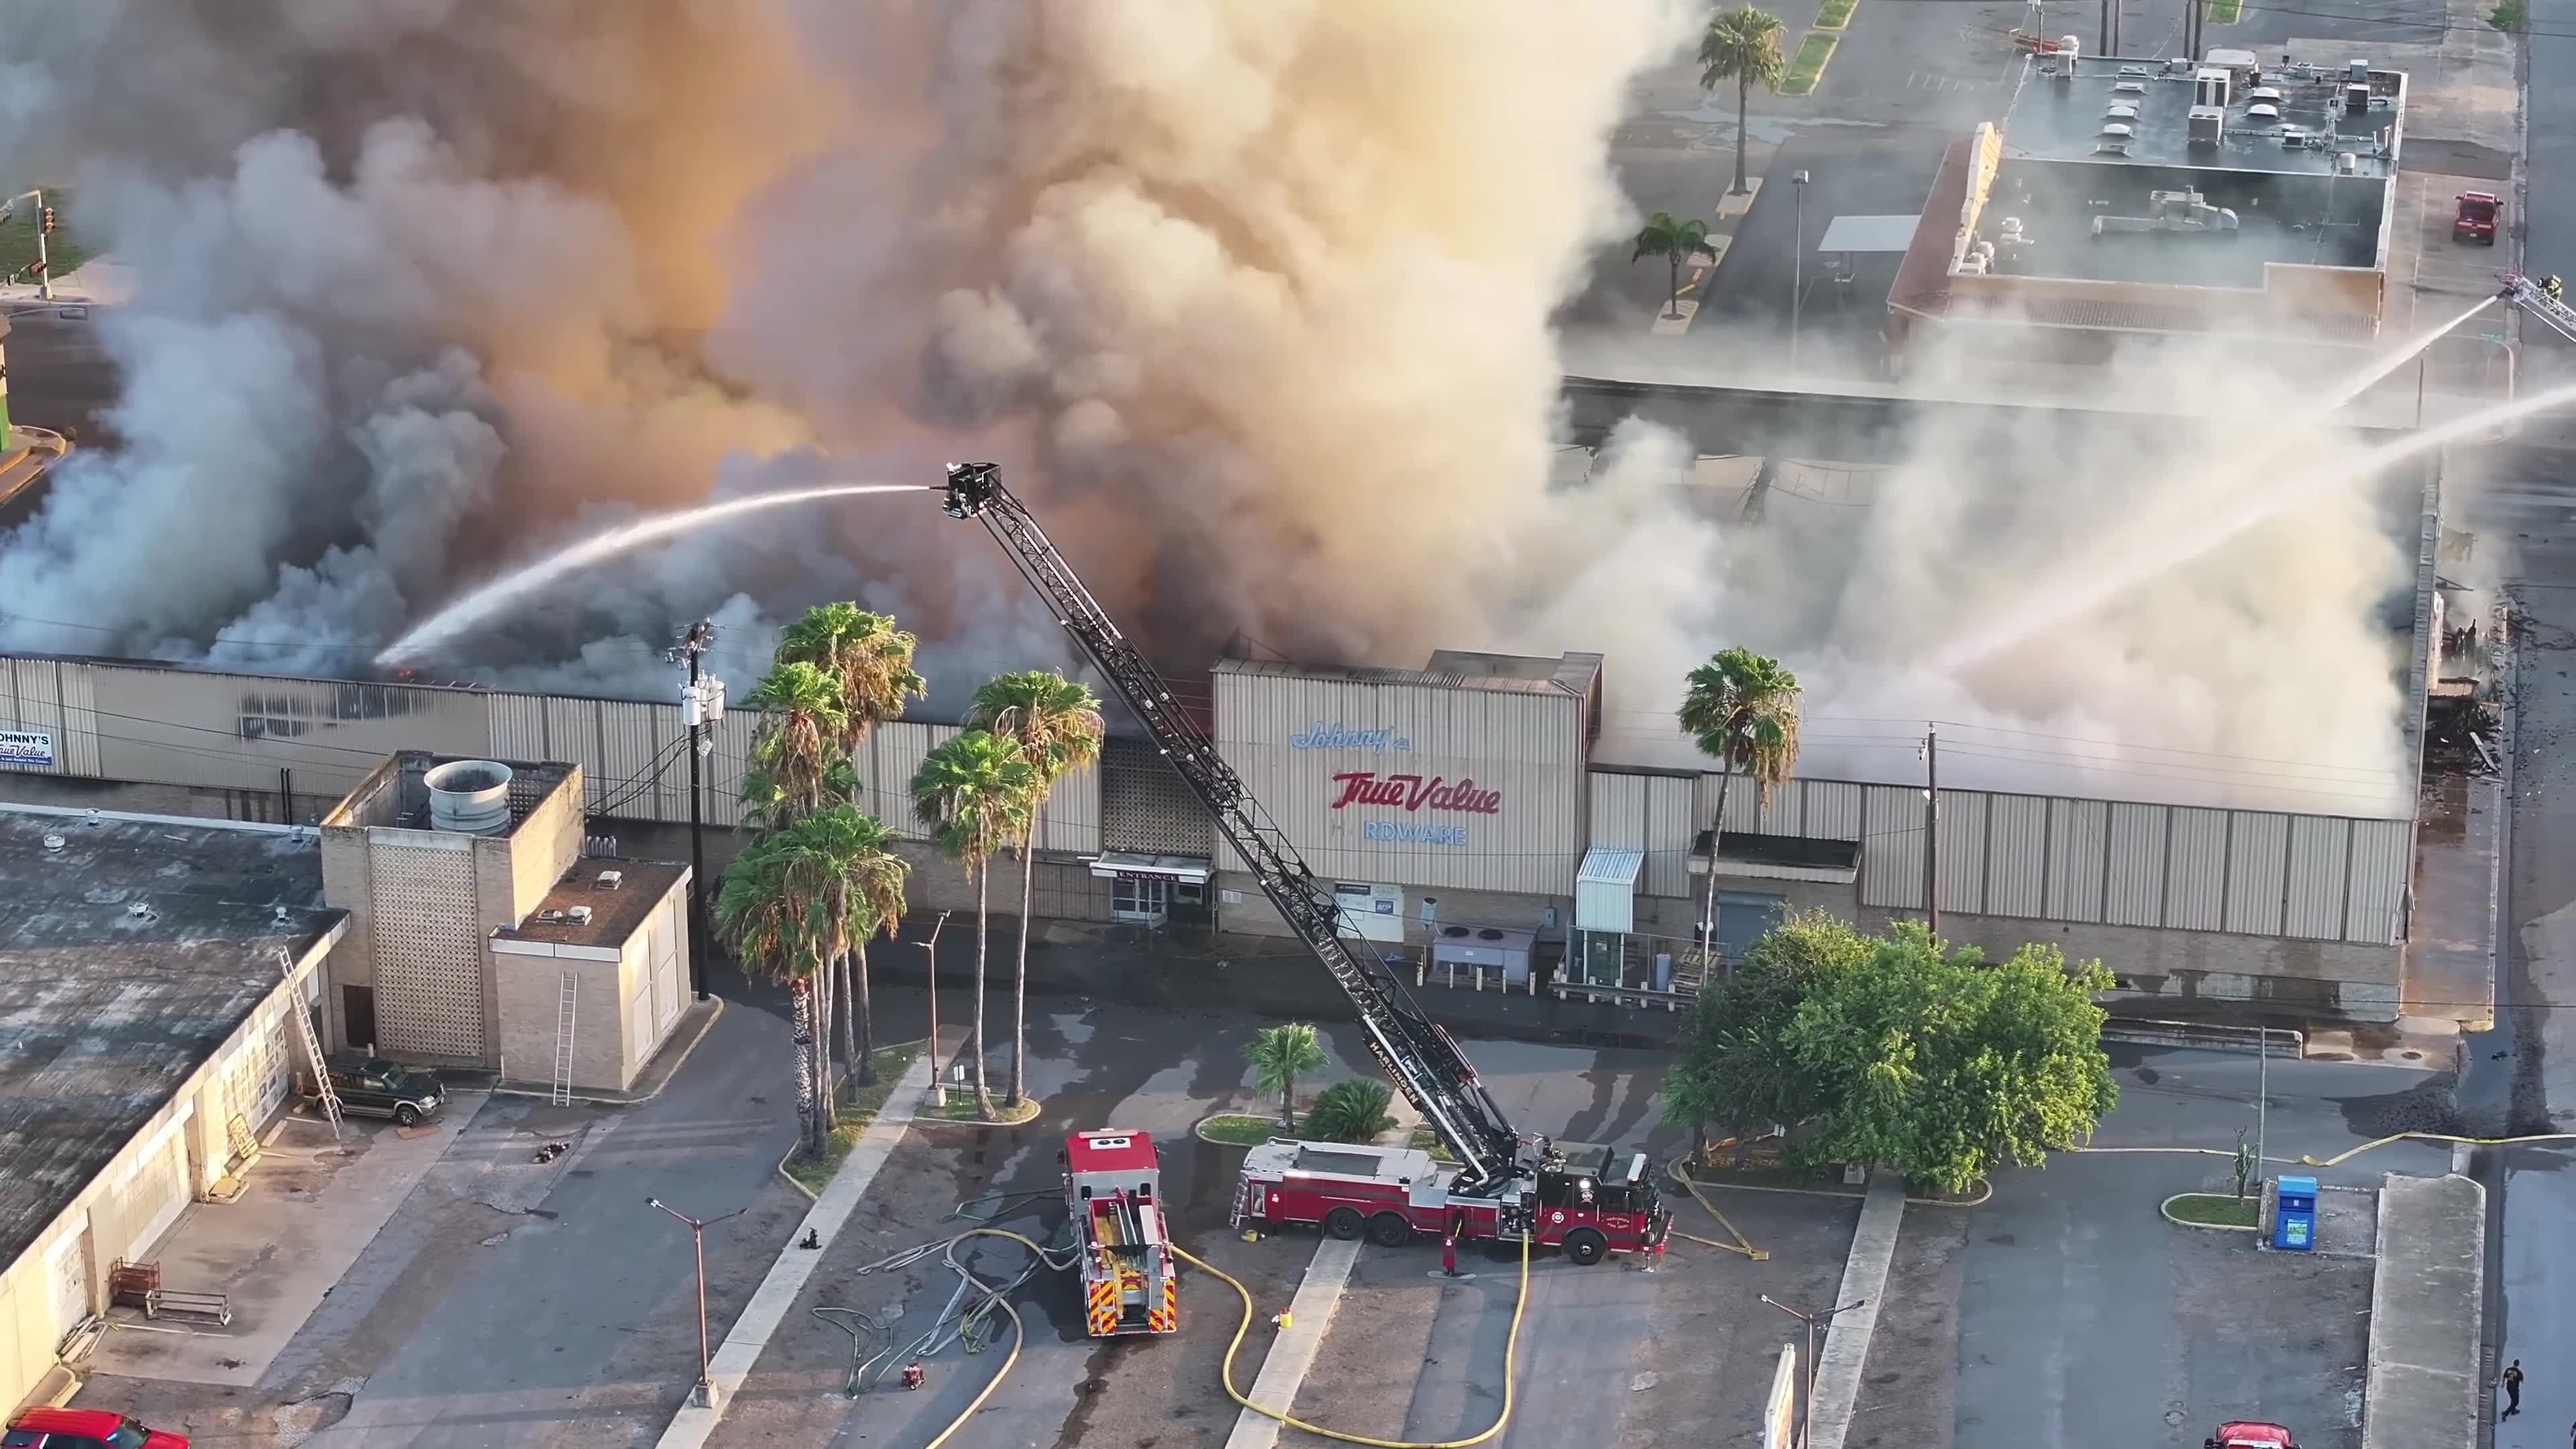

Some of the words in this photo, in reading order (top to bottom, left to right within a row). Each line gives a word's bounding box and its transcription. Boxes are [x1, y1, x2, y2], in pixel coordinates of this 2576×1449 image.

[10, 745, 46, 757] Value
[1332, 772, 1405, 809] True
[1388, 773, 1501, 814] Value
[1118, 872, 1177, 881] ENTRANCE
[1370, 1042, 1419, 1104] HARLINGEN
